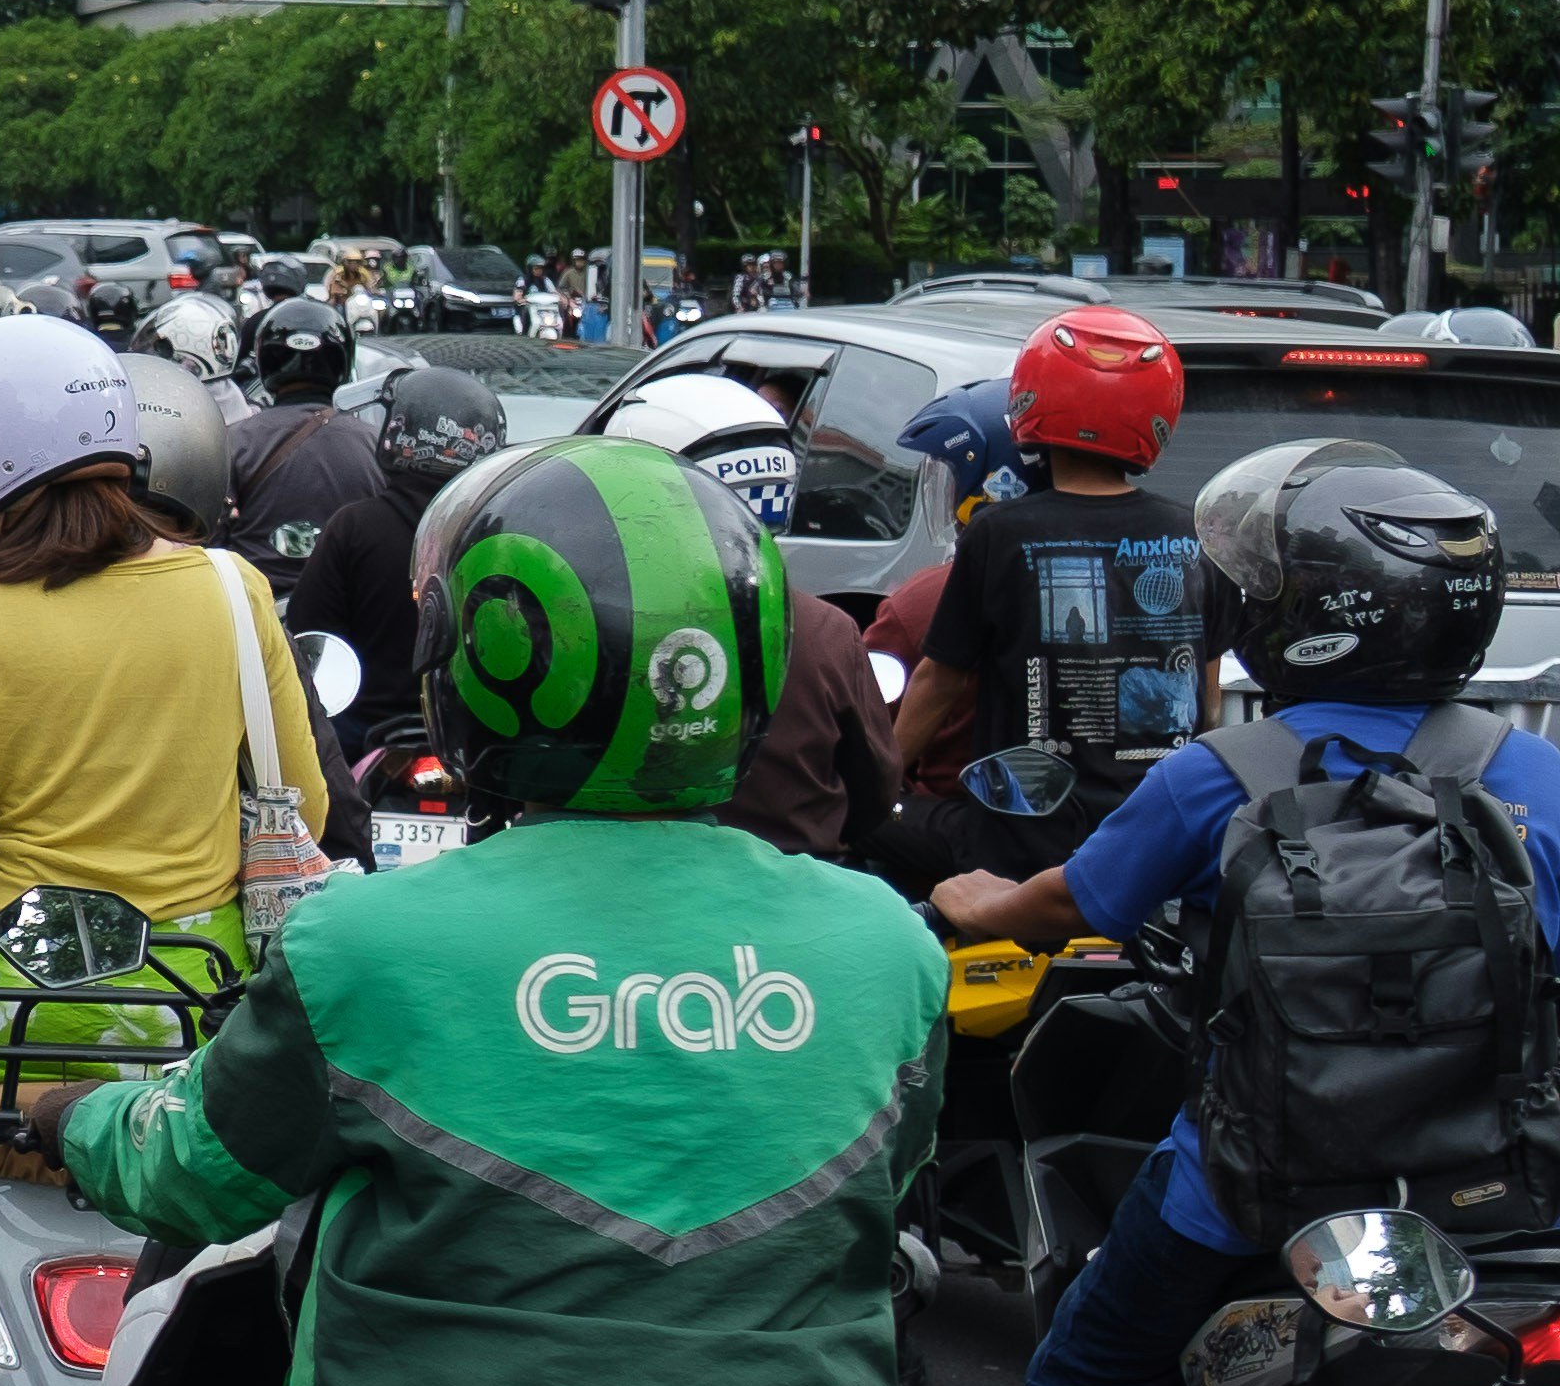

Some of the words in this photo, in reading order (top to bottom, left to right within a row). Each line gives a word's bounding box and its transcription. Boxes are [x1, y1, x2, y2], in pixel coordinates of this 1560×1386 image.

[716, 455, 788, 480] POLISI
[1113, 535, 1202, 561] Anxiety
[1444, 577, 1482, 593] VEGA
[1298, 638, 1343, 659] GMT
[649, 716, 719, 741] gojek
[393, 823, 446, 843] 3357
[517, 944, 816, 1054] Grab
